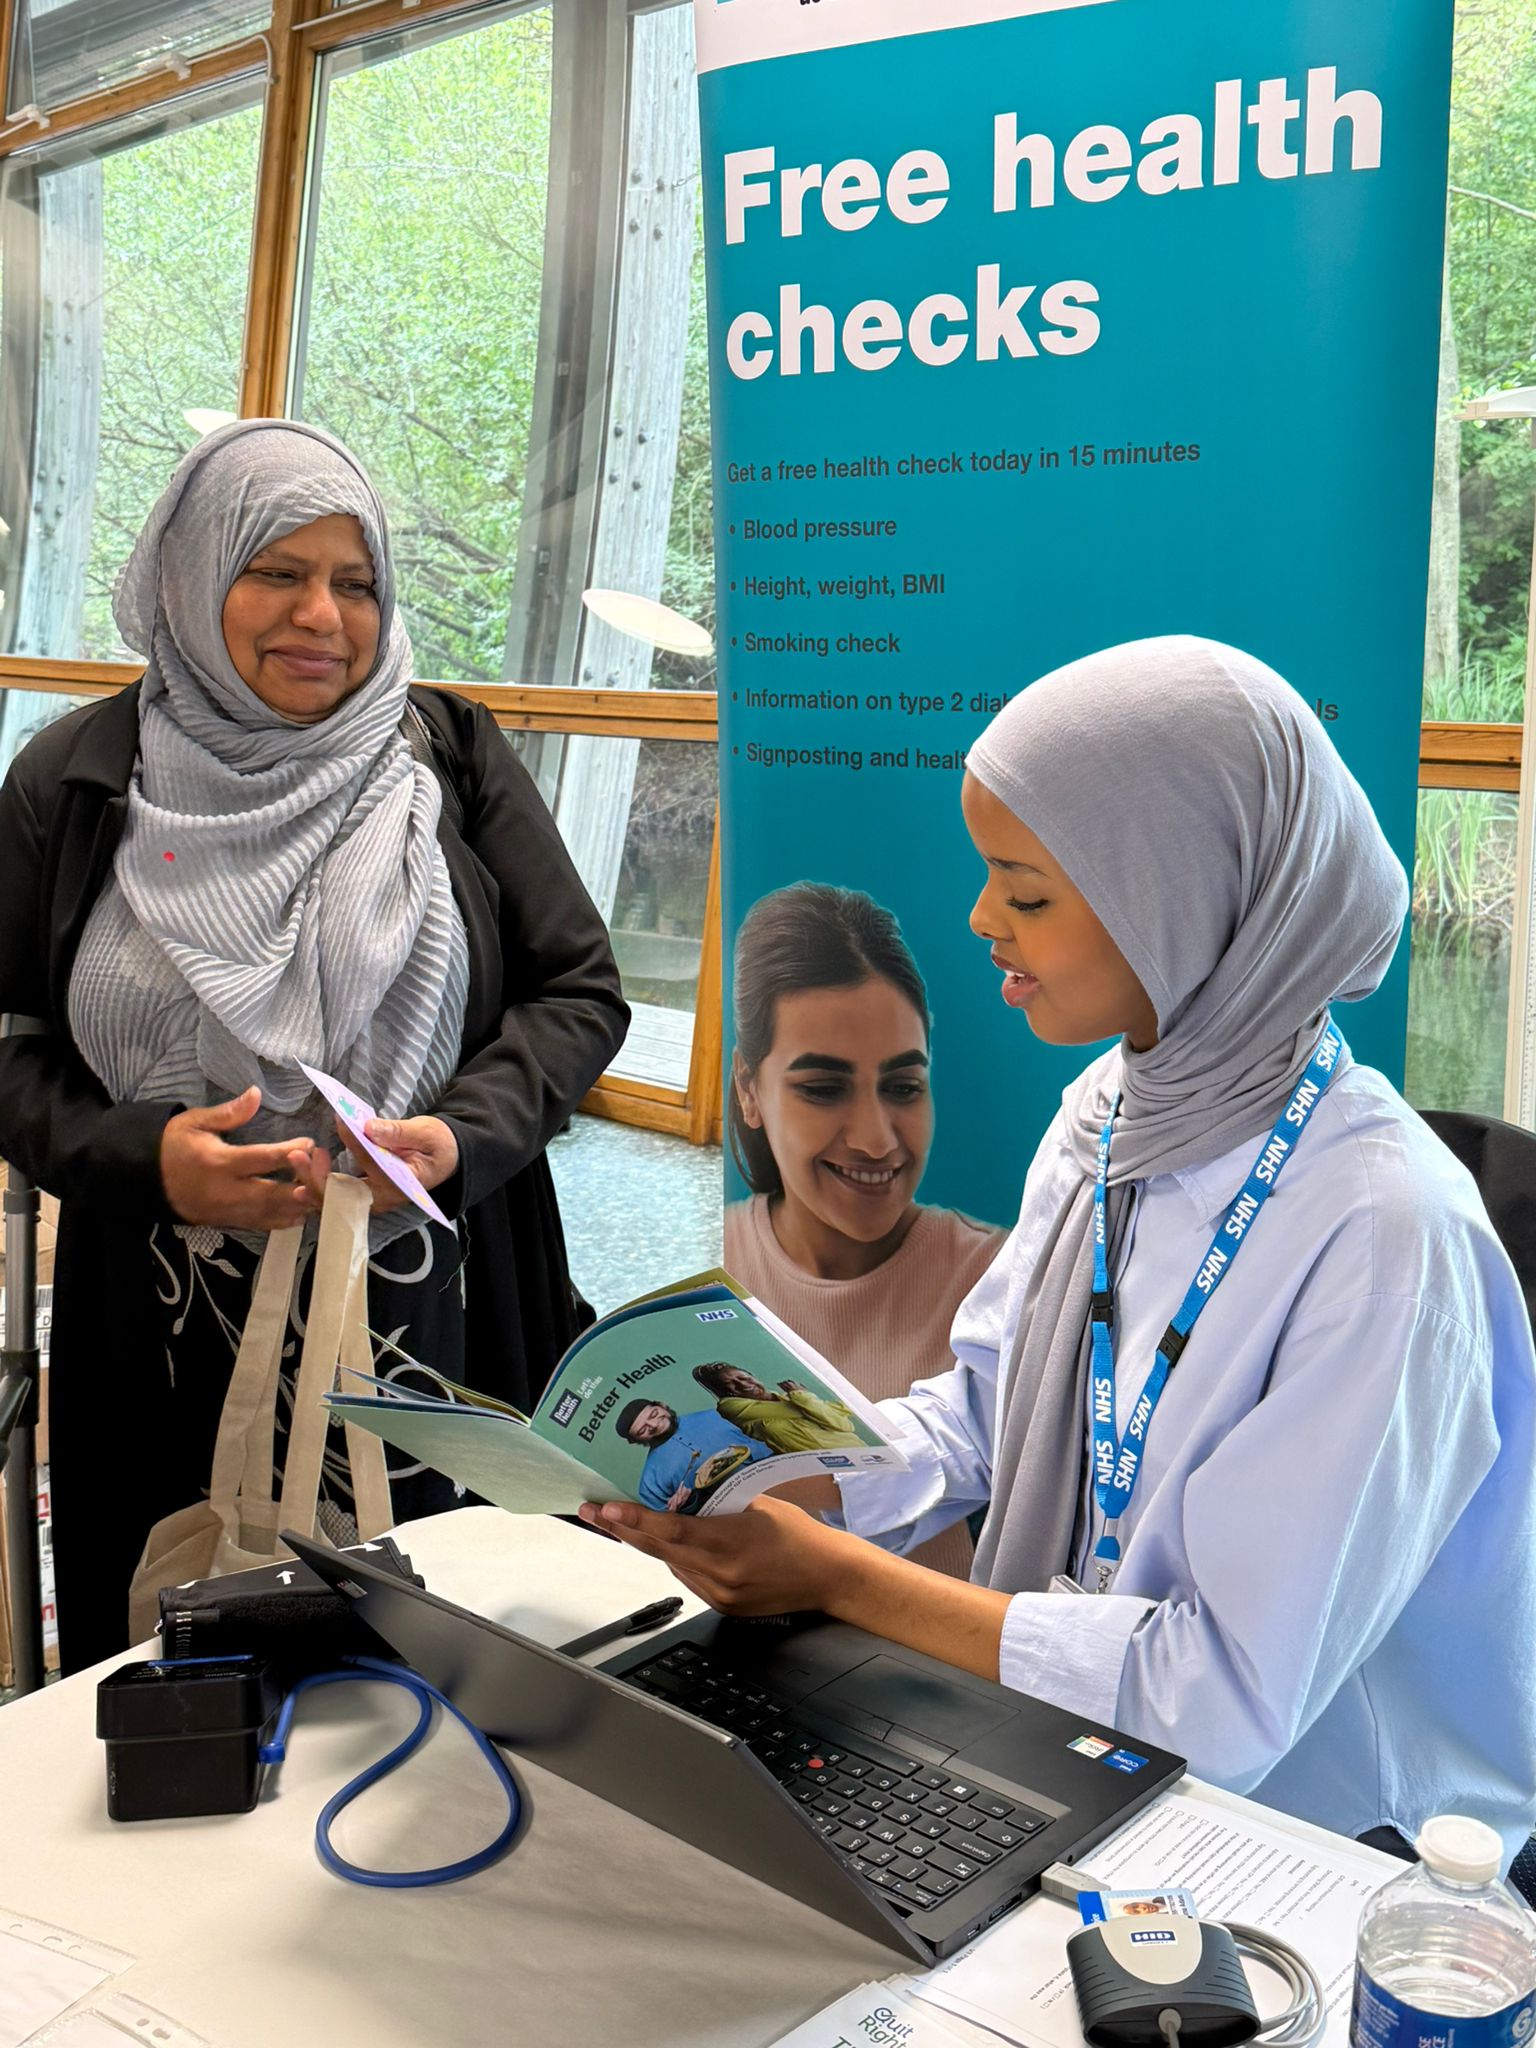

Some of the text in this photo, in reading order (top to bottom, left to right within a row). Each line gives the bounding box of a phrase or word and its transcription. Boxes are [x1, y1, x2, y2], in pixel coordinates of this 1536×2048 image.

[724, 65, 1383, 245] Free health
[727, 263, 1101, 380] checks
[728, 441, 1201, 483] Get a free health check today in 15 minutes
[744, 518, 897, 542] Blood pressure
[744, 574, 945, 600] Height, weight, BMI
[745, 632, 901, 657] Smoking check
[745, 688, 859, 710] Information
[865, 694, 893, 711] on
[899, 692, 945, 715] type
[950, 692, 964, 712] 2
[746, 743, 863, 770] Signposting
[869, 748, 909, 768] and
[1316, 1032, 1340, 1072] NHS
[1286, 1078, 1320, 1127] NHS
[1256, 1135, 1290, 1184] NHS
[1225, 1192, 1259, 1240] NHS
[1196, 1247, 1228, 1294] NHS
[700, 1311, 734, 1322] NHS
[578, 1354, 677, 1443] Better Health
[1095, 1377, 1112, 1423] NHS
[1129, 1393, 1152, 1441] NHS
[1096, 1440, 1115, 1485] NHS
[1113, 1447, 1138, 1492] NHS
[873, 2007, 914, 2039] Quit
